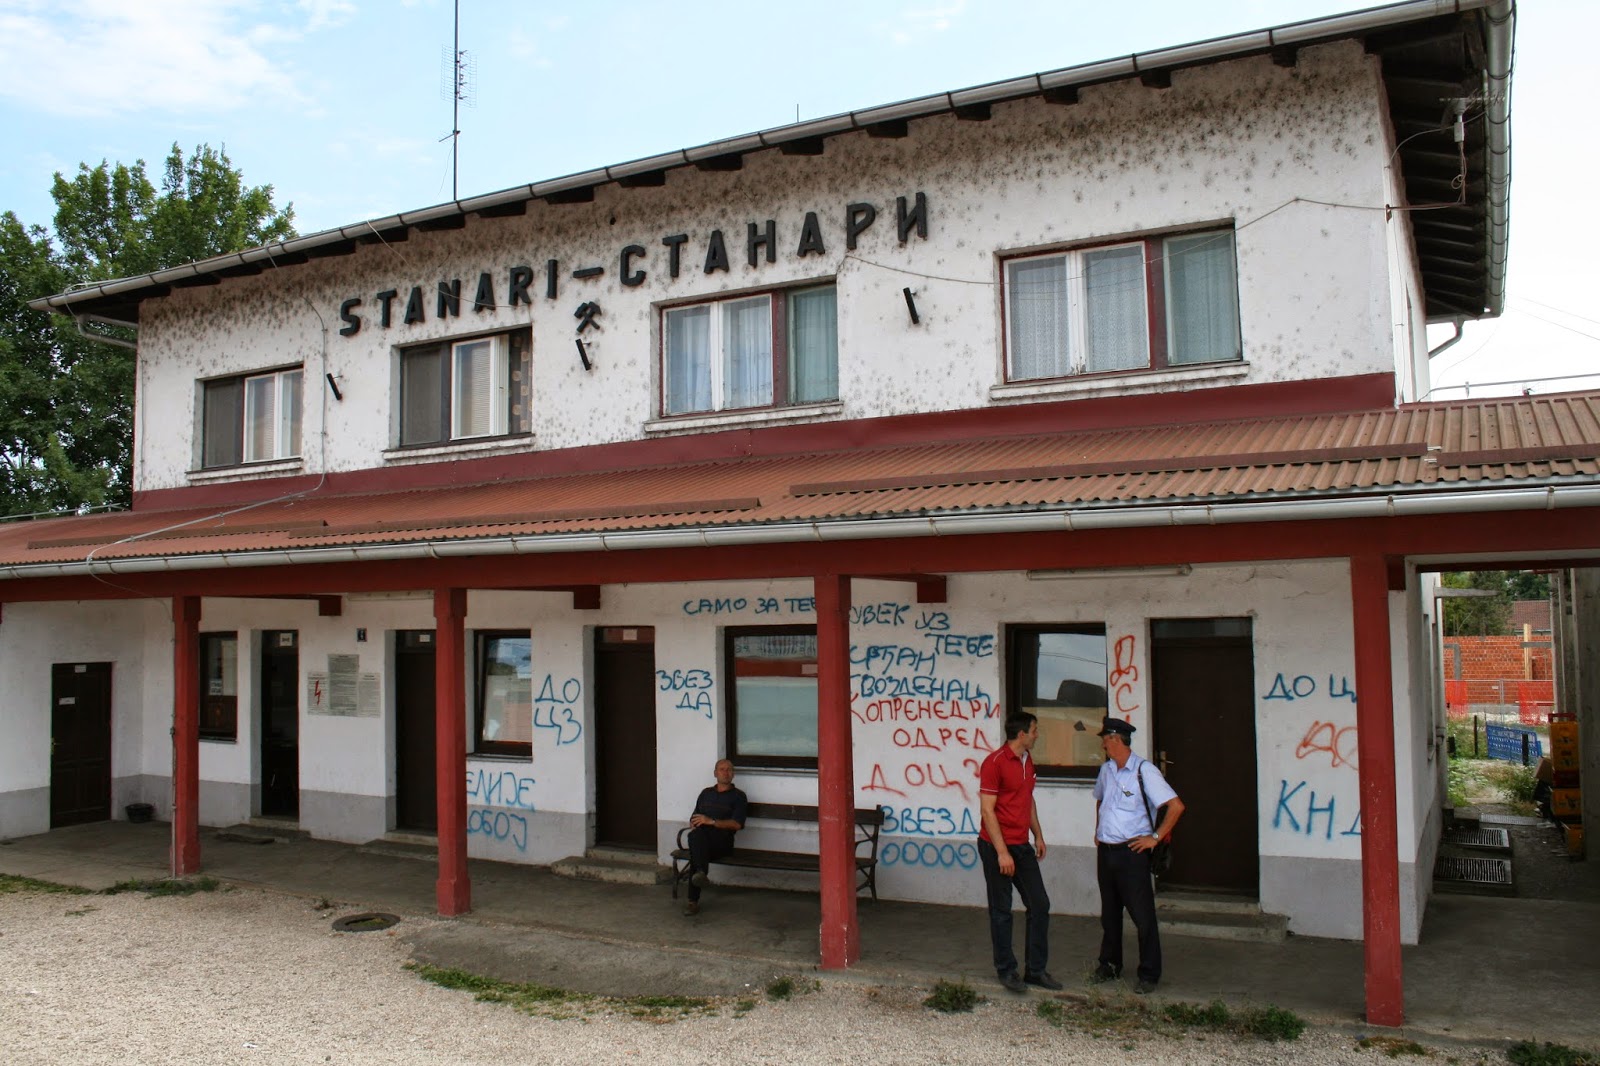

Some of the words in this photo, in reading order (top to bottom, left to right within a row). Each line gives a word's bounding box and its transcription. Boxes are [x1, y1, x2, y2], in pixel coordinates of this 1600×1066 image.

[682, 597, 748, 615] САМО
[754, 597, 780, 614] ЗА
[924, 632, 994, 658] ТЕБЕ
[534, 673, 582, 705] ДО
[1262, 672, 1316, 701] ДО
[466, 809, 527, 851] ОБОЈ
[880, 805, 980, 836] ЗВЕЗД
